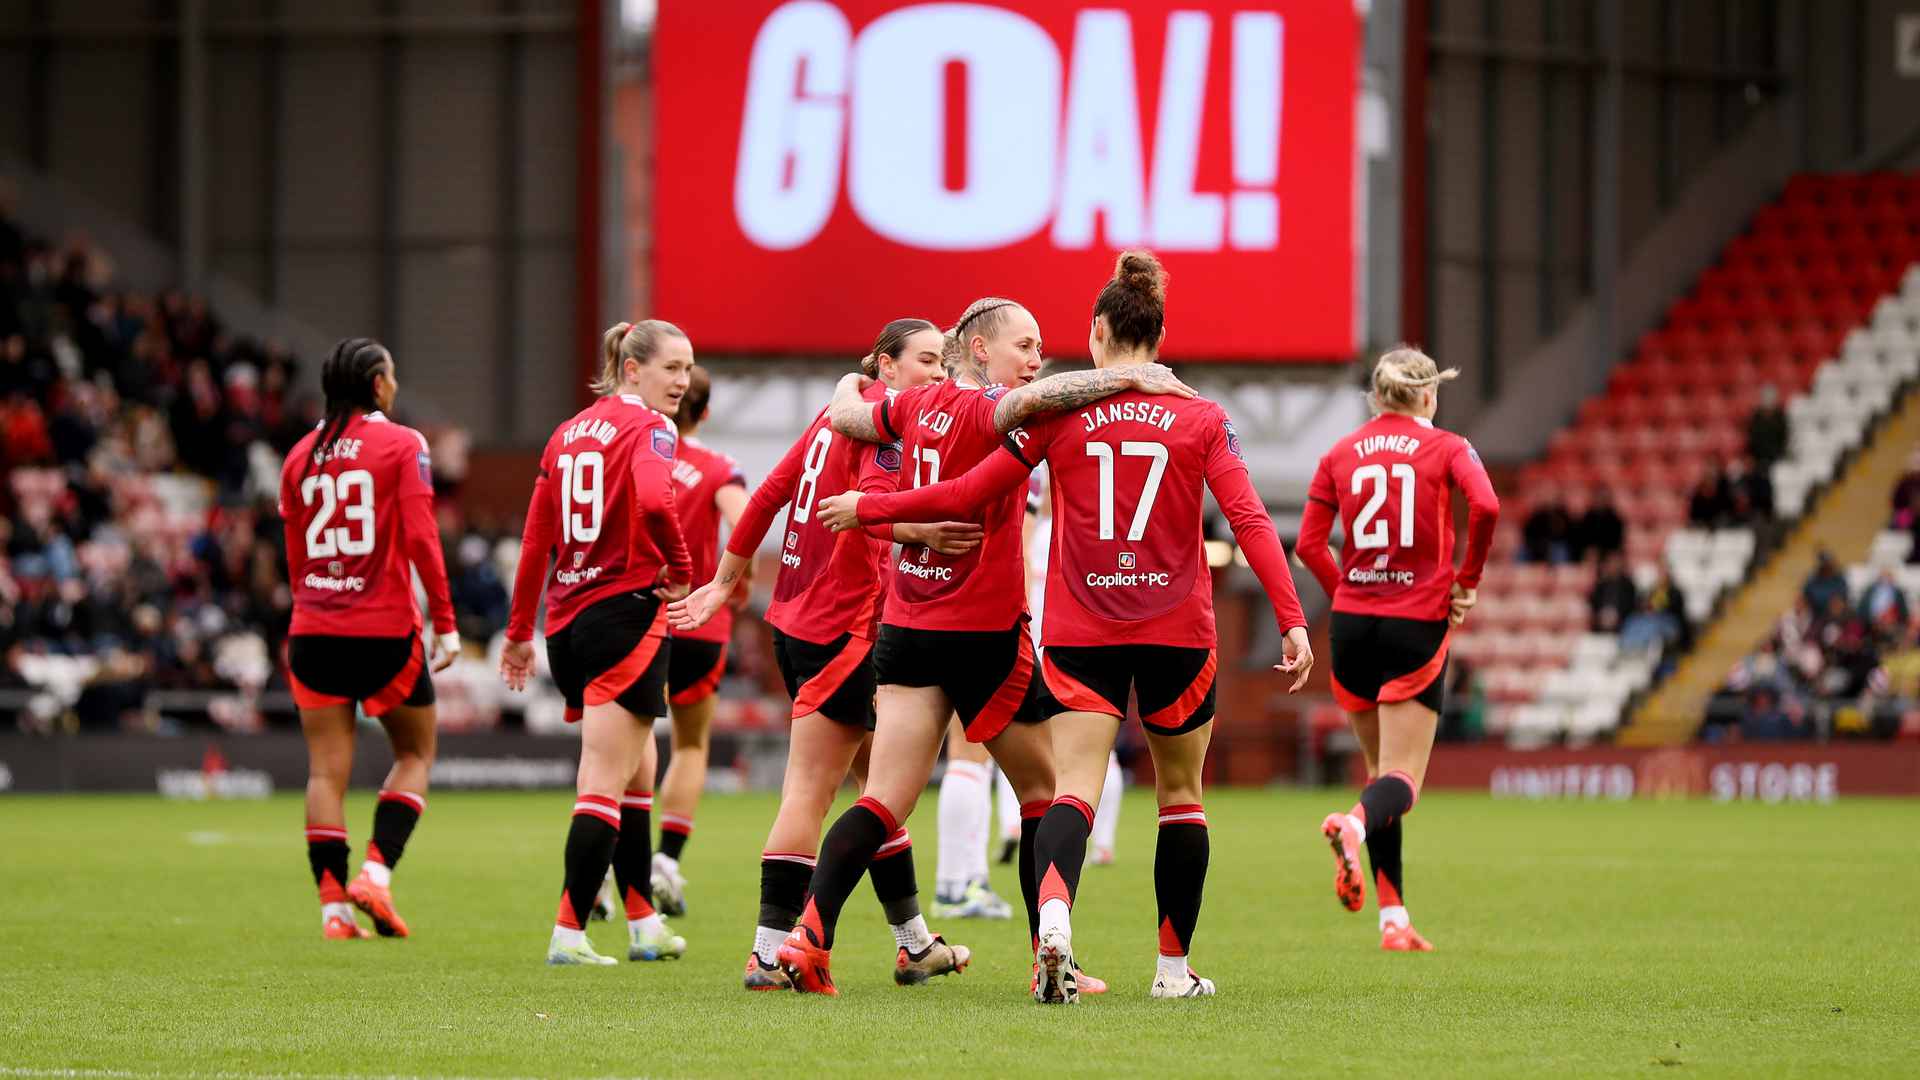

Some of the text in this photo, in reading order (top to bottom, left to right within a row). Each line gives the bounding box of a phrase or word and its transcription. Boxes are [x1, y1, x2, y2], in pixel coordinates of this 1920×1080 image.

[732, 0, 1287, 251] GOAL!
[1080, 402, 1177, 433] JANSSEN
[1353, 434, 1421, 460] TURNER
[301, 469, 376, 560] 23
[557, 451, 605, 545] 19
[794, 426, 833, 525] 8
[1086, 441, 1169, 541] 17
[1351, 463, 1416, 550] 21
[1490, 762, 1840, 803] UNITED STORE
